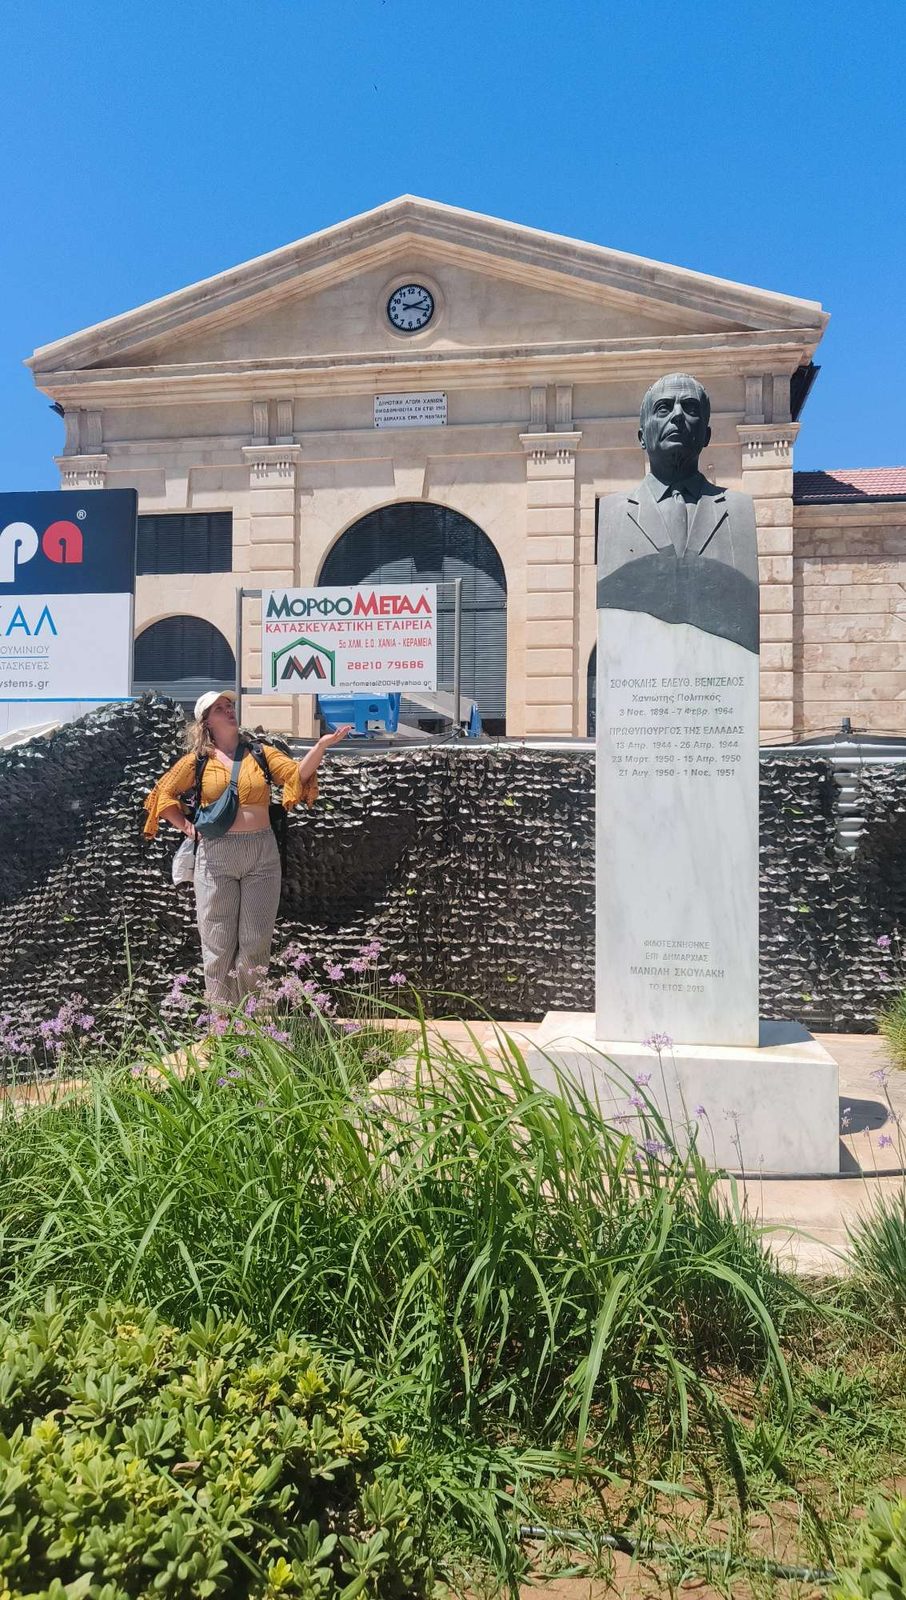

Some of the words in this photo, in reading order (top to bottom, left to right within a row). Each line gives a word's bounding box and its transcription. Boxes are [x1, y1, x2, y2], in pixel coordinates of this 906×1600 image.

[0, 604, 58, 636] ΑΛ
[266, 622, 373, 633] ΚΑΤΑΣΚΕΥΑΣΤΙΚΗ
[377, 620, 432, 631] ΕΤΑΙΡΕΙΑ
[378, 638, 397, 648] ΧΑΝΙΑ
[403, 637, 432, 647] ΚΕΡΑΜΕΙΑ
[347, 661, 382, 670] 28210
[388, 660, 424, 669] 79686
[610, 678, 657, 688] ΣΟΦΟΚΛΗΣ
[695, 677, 744, 687] ΒΕΝΙΖΕΛΟΣ
[609, 727, 681, 735] ΠΡΩΘΥΠΟΥΡΓΟΣ
[684, 726, 701, 734] ΤΗΣ
[704, 726, 744, 734] ΕΛΛΑΔΑΣ
[662, 953, 709, 962] ΔΗΜΑΡΧΙΑΣ
[630, 966, 669, 976] ΜΑΝΩΛΗ
[674, 968, 724, 978] ΣΚΟΥΛΑΚΗ
